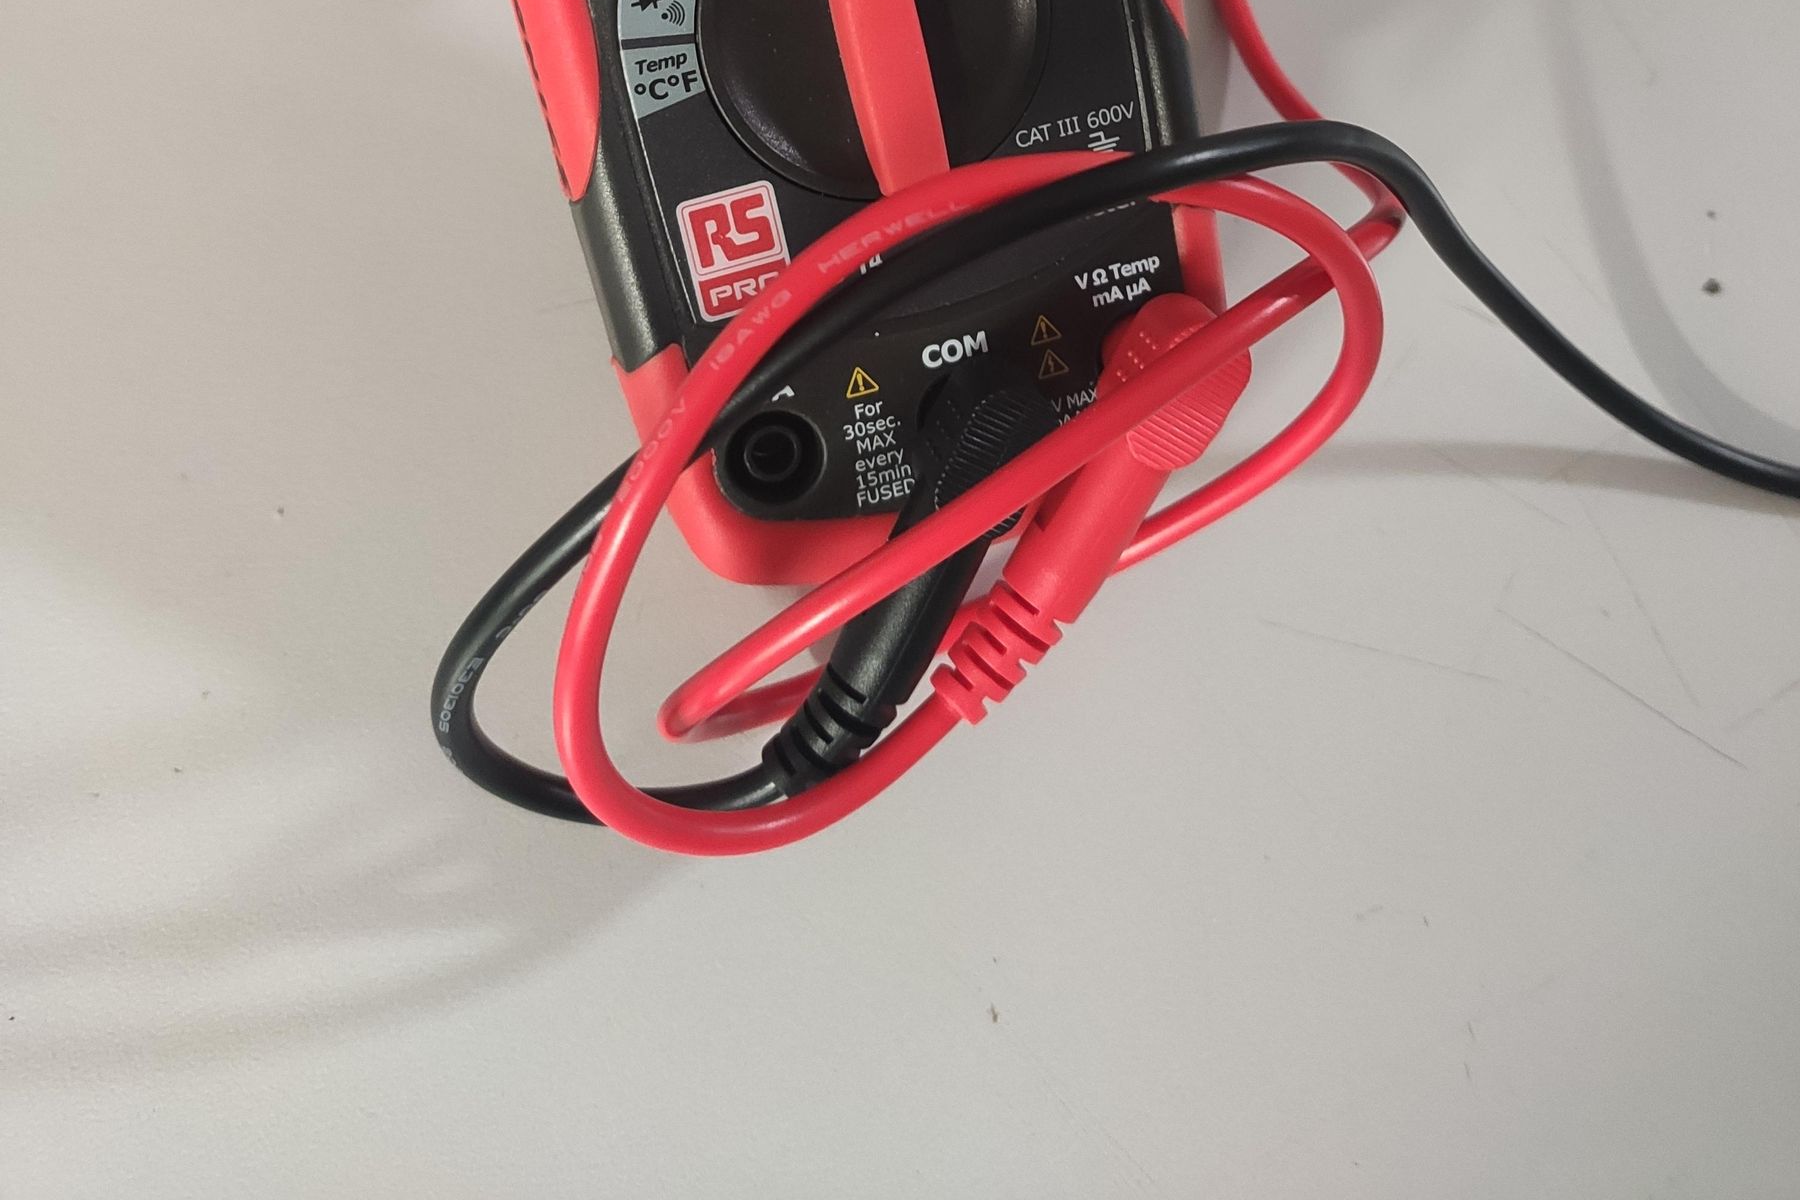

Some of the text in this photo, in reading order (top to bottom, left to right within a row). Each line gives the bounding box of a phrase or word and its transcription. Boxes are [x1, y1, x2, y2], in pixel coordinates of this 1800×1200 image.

[635, 52, 688, 75] Temp
[1015, 101, 1135, 148] CAT III 600V
[688, 193, 776, 269] RS
[1074, 272, 1088, 290] V
[1108, 255, 1160, 280] Temp
[1092, 285, 1124, 308] mA
[922, 330, 989, 369] COM
[854, 401, 883, 419] For
[1066, 387, 1098, 409] MAX
[843, 415, 901, 440] 30sec.
[856, 430, 897, 454] MAX
[855, 448, 904, 472] every
[856, 464, 912, 490] 15min
[856, 478, 915, 508] FUSED
